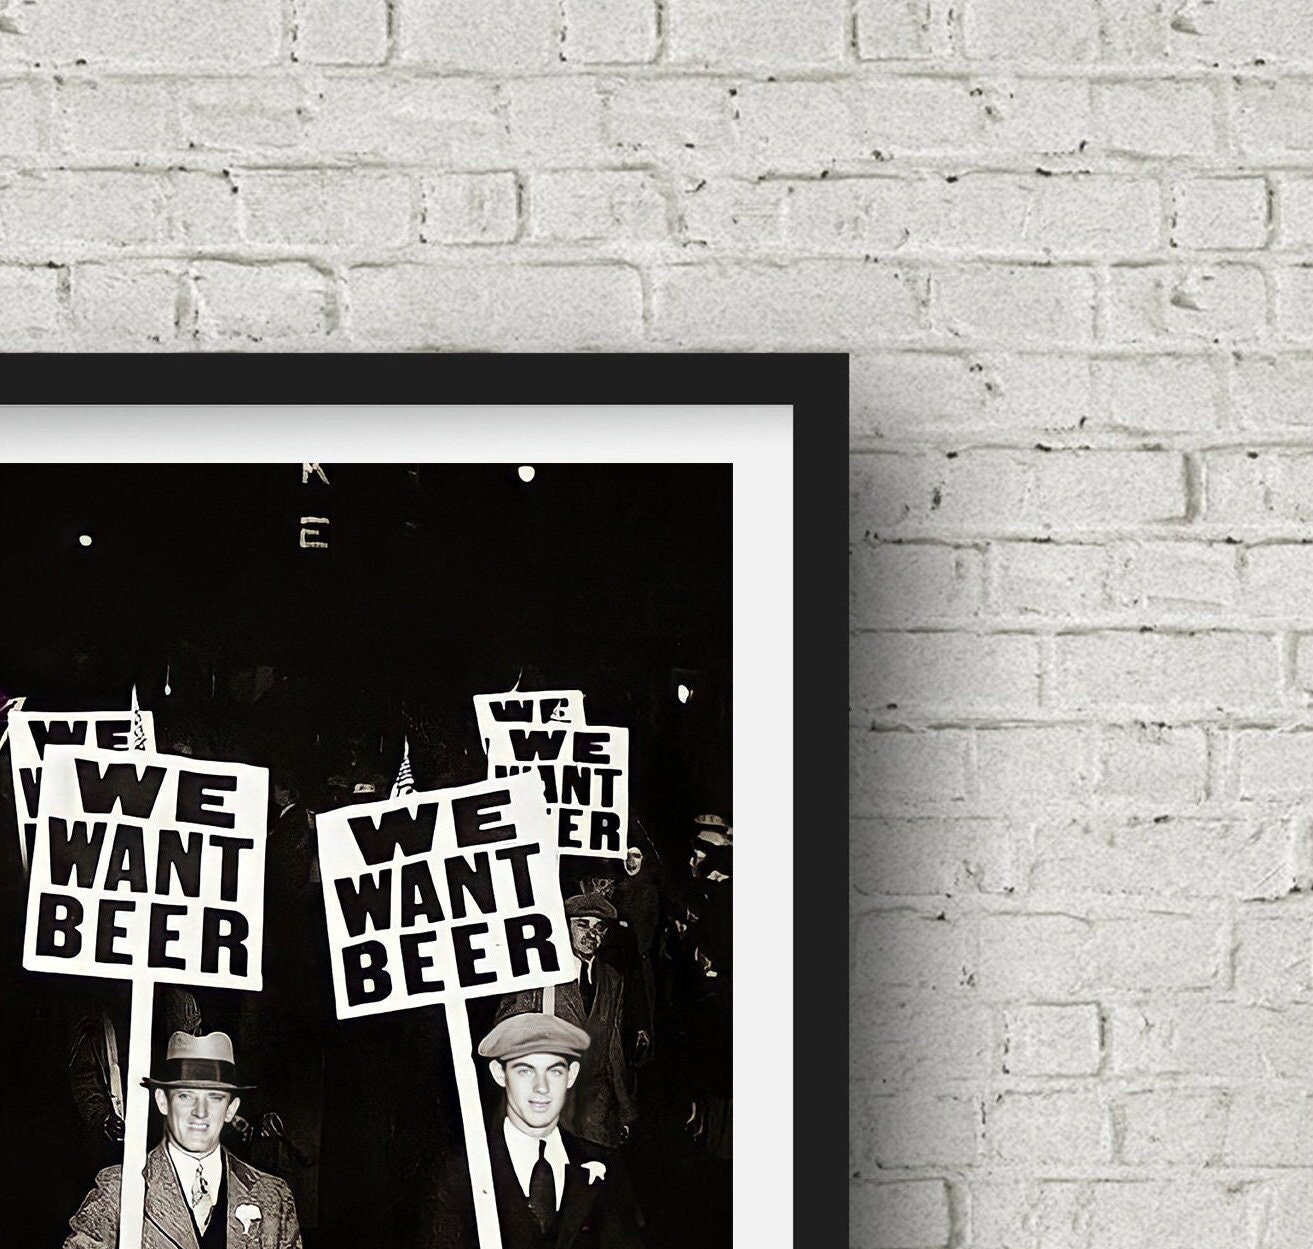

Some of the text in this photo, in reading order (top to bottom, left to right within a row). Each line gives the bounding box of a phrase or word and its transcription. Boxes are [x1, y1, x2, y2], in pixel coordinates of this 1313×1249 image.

[27, 719, 132, 761] WE
[488, 697, 572, 724] WE
[508, 729, 611, 765] WE
[74, 757, 238, 829] WE
[494, 764, 623, 808] ANT
[48, 816, 254, 902] WANT
[347, 788, 517, 866] WE
[545, 807, 621, 851] ER
[333, 842, 540, 938] WANT
[35, 891, 250, 978] BEER
[341, 913, 560, 1007] BEER
